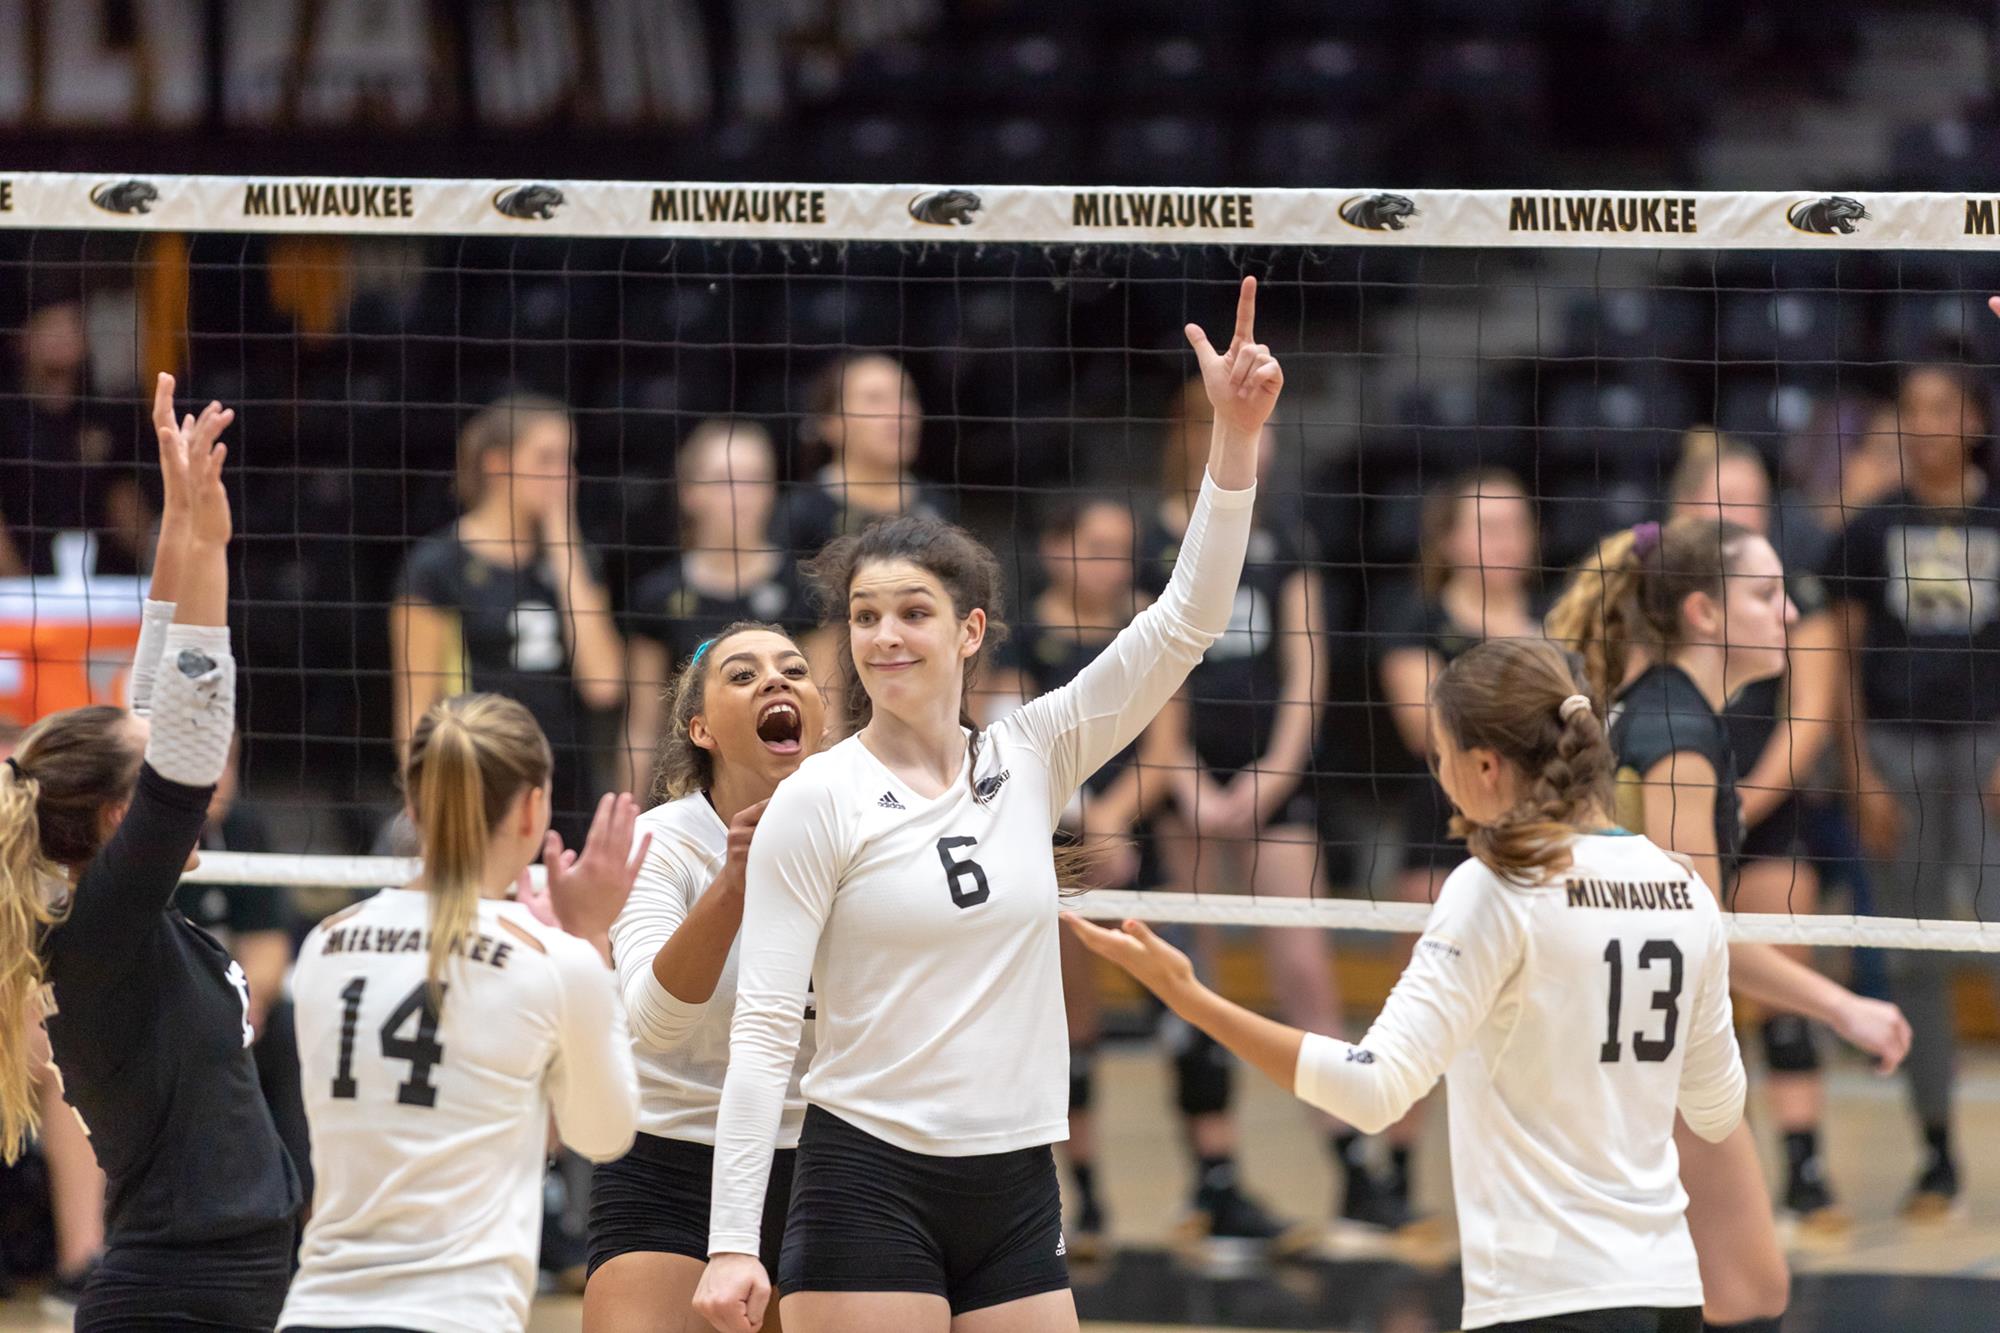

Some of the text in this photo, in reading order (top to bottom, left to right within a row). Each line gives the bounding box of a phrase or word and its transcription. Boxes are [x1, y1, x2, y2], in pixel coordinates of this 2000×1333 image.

[244, 184, 413, 217] MILWAUKEE
[651, 189, 825, 224] MILWAUKEE
[1072, 193, 1253, 228] MILWAUKEE
[1509, 197, 1697, 233] MILWAUKEE
[936, 835, 991, 909] 6
[1565, 878, 1694, 910] MILWAUKEE
[1600, 938, 1684, 1062] 13
[331, 976, 449, 1108] 14
